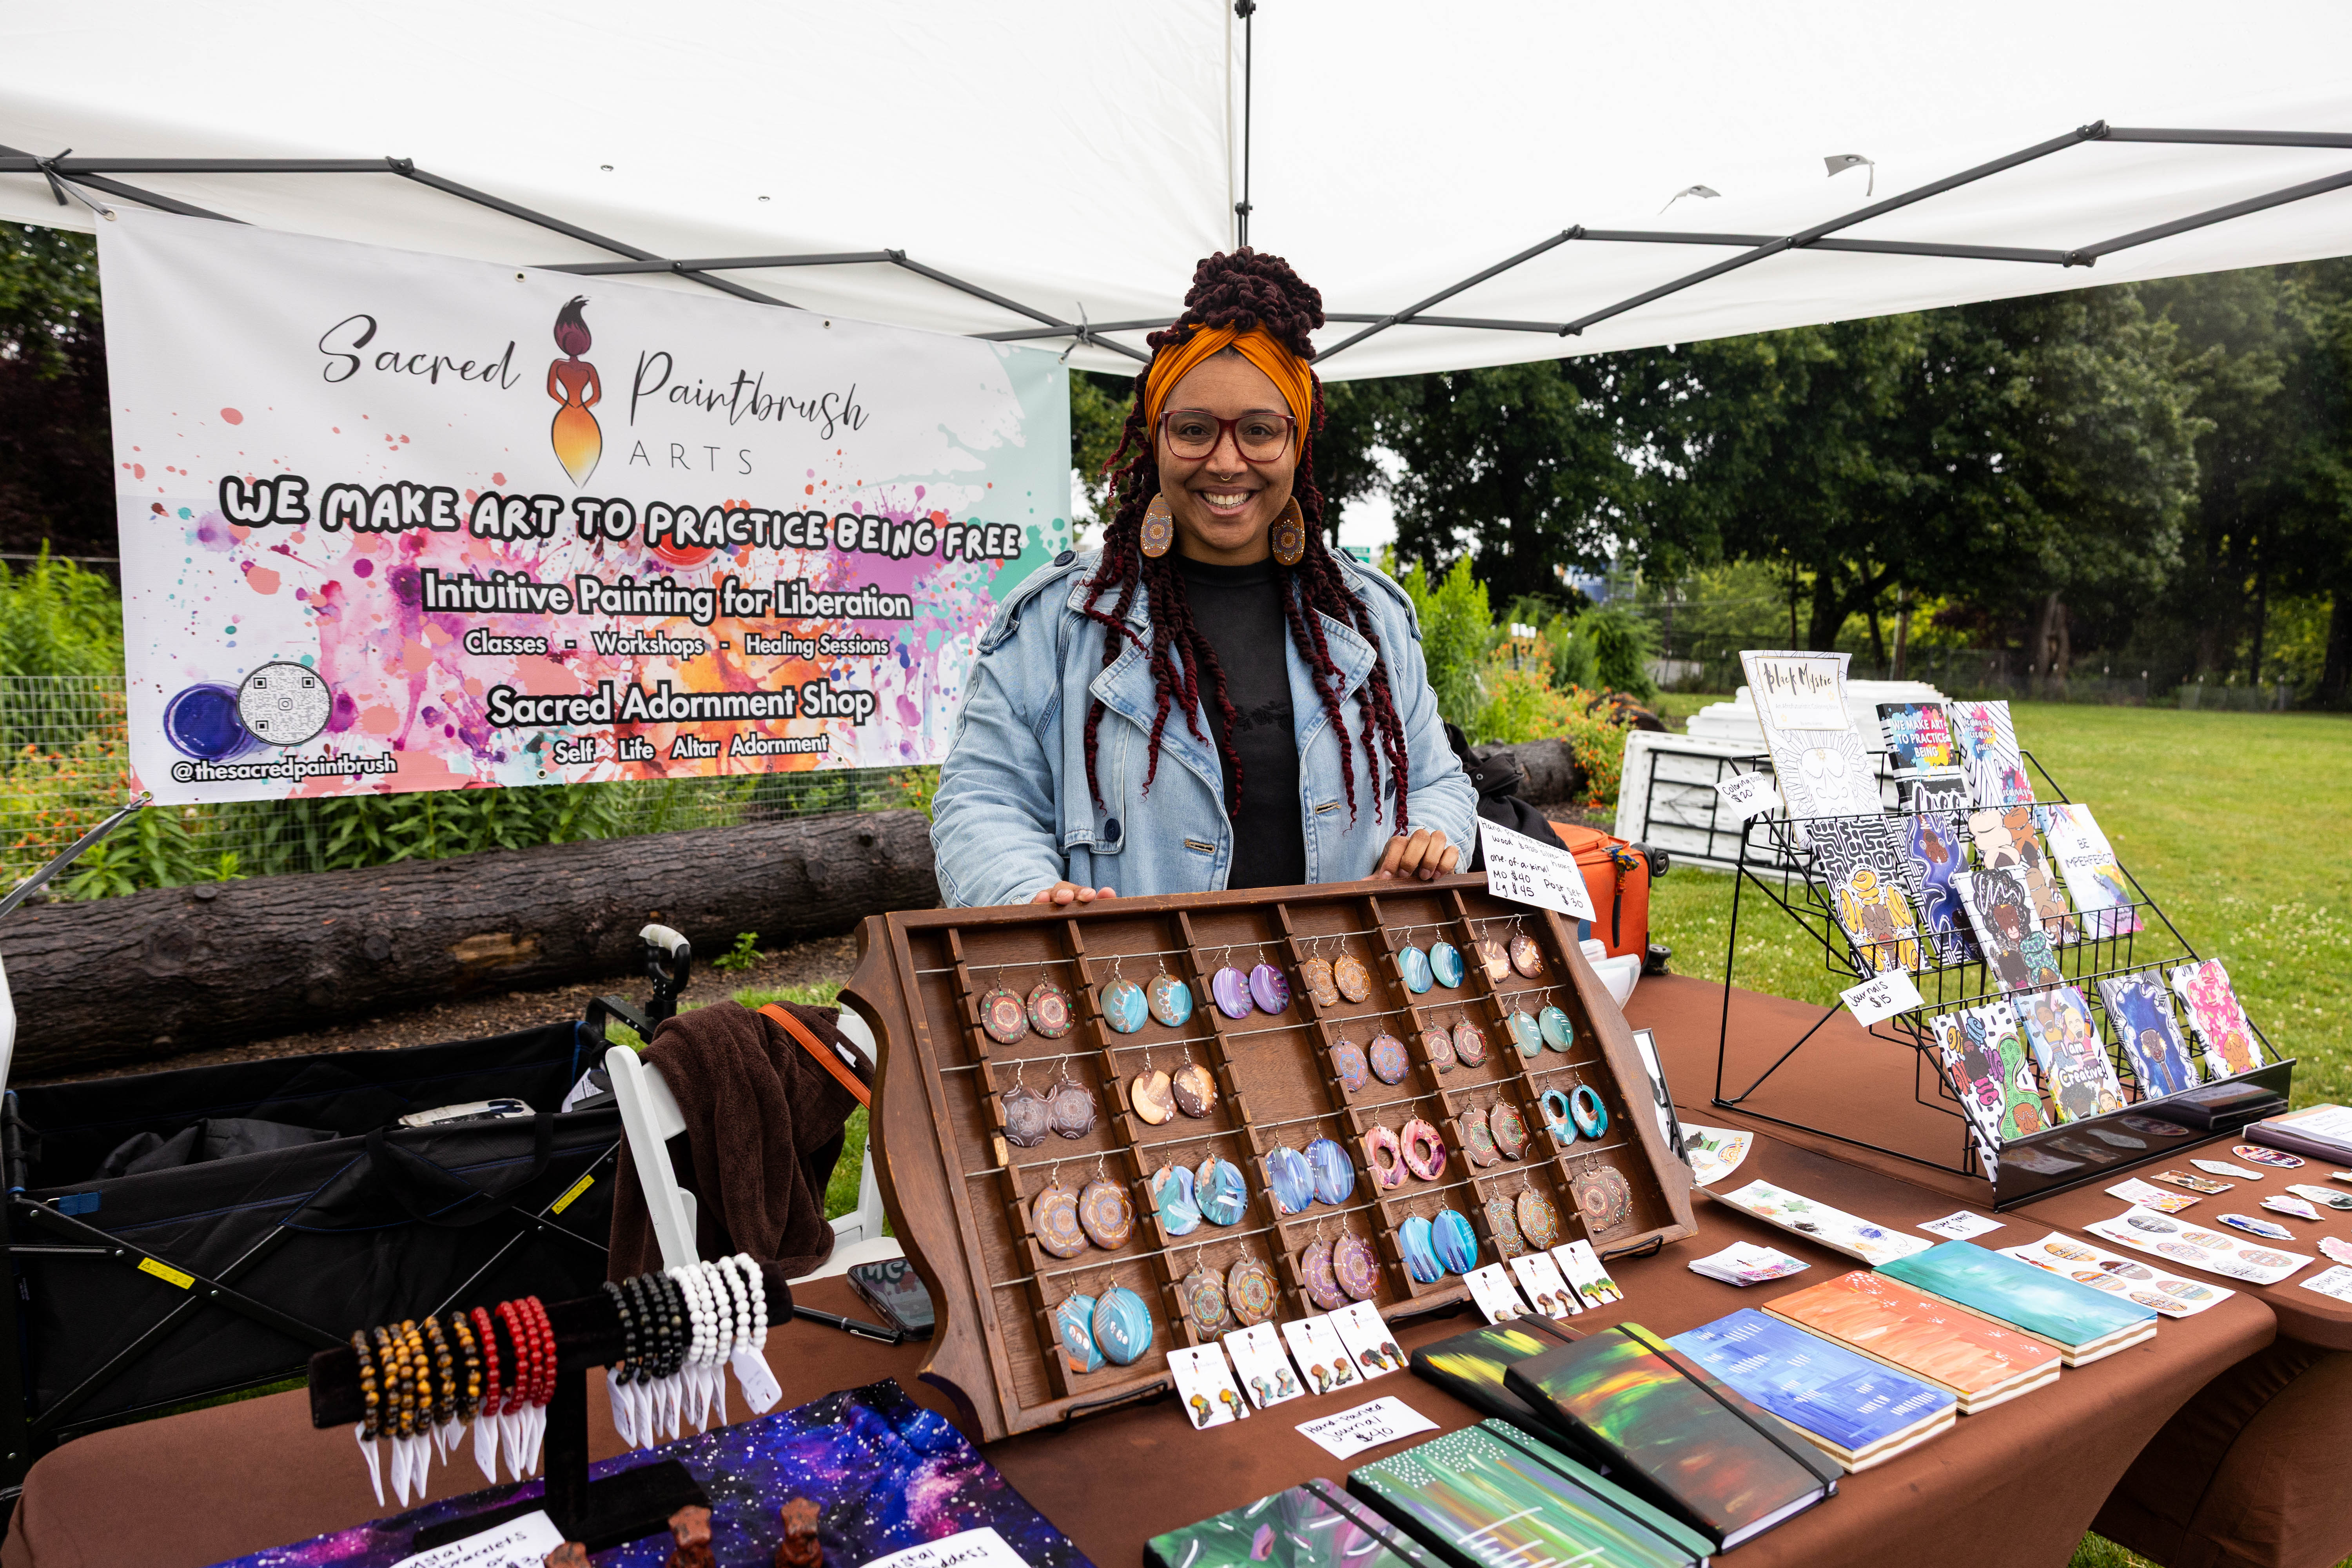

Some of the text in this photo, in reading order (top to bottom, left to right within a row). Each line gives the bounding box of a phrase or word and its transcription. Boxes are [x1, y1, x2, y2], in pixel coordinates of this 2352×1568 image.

[319, 314, 869, 440] Sacred Paintbrush
[630, 439, 753, 475] ARTS
[219, 475, 1021, 562] WE MAKE ART TO PRACTICE BEING FREE
[421, 568, 914, 625] Intuitive Painting for Liberation
[464, 626, 890, 661] Classes - Workshops - Healing Sessions
[1764, 662, 1832, 696] Black Mystic
[486, 677, 876, 728] Sacred Adornment Shop
[1891, 719, 1945, 731] WE MAKE ART
[1896, 732, 1947, 744] TO PRACTICE
[554, 732, 829, 765] Self Life Altar Adornment
[1913, 746, 1939, 757] BEING
[171, 751, 399, 784] @thesacredpaintbrush
[1722, 779, 1755, 795] Coloring
[1731, 789, 1753, 803] $20
[2077, 838, 2090, 849] BE
[1551, 860, 1572, 873] hooks
[1493, 870, 1531, 883] MD $40
[1512, 882, 1534, 897] $45
[1561, 893, 1583, 908] $30
[1847, 981, 1888, 1007] Journals
[1869, 994, 1891, 1008] $15
[2060, 1041, 2085, 1058] I am
[2058, 1059, 2109, 1088] Creative!
[1353, 1427, 1394, 1442] $40
